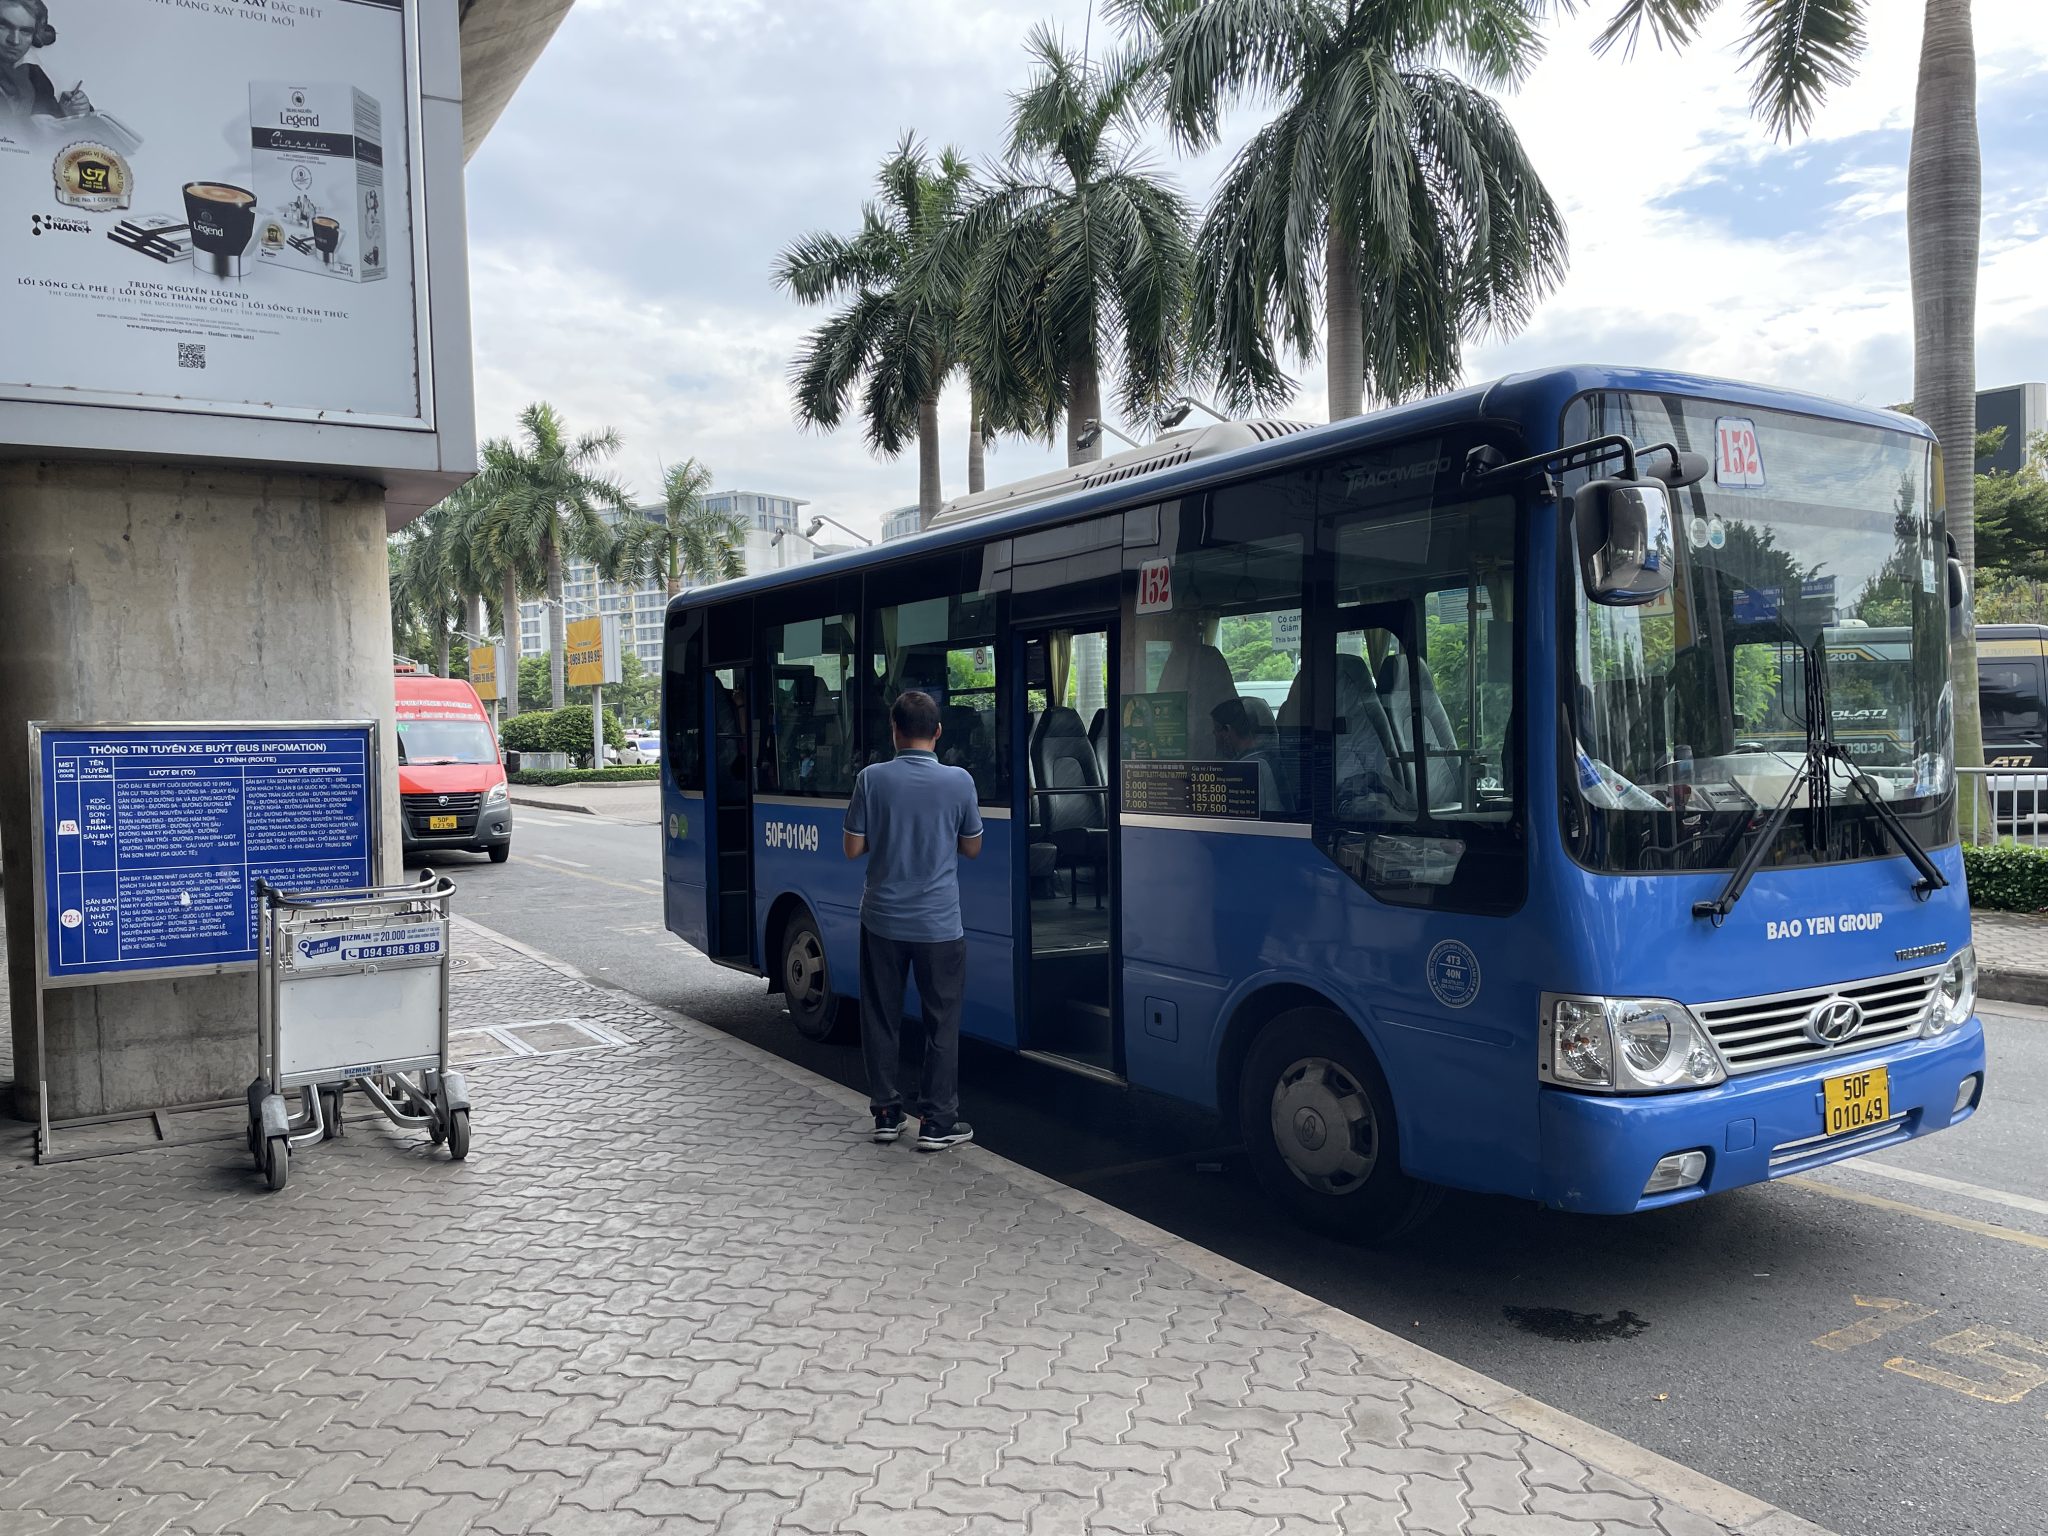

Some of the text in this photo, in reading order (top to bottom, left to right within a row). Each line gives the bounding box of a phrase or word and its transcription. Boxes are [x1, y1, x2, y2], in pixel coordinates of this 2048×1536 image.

[213, 5, 234, 17] XAY
[238, 9, 267, 23] TƯƠI
[271, 15, 295, 28] MỚI
[299, 6, 322, 19] BIỆT
[280, 111, 319, 129] Legend
[80, 167, 106, 182] G7
[53, 216, 71, 224] CÔNG
[192, 220, 223, 238] Legend
[39, 279, 68, 290] SỐNG
[71, 282, 86, 292] CÀ
[88, 284, 110, 295] PHÊ
[171, 292, 206, 303] THÀNH
[209, 297, 239, 307] CÔNG
[128, 280, 249, 301] TRUNG NGUYÊN LEGEND
[1719, 428, 1758, 475] 152
[1140, 565, 1170, 605] 152
[89, 742, 327, 755] THÔNG TIN TUYẾN XE BUÝT (BUS INFOMATION)
[227, 755, 247, 764] TRÌNH
[248, 755, 277, 765] (ROUTE)
[84, 766, 109, 774] TUYẾN
[149, 769, 170, 778] LƯỢT
[180, 769, 196, 777] (TO)
[277, 767, 297, 776] LƯỢT
[309, 766, 341, 775] (RETURN)
[1191, 773, 1216, 783] 3.000
[1125, 781, 1147, 791] 5.000
[1191, 784, 1227, 794] 112.500
[1125, 790, 1147, 800] 6.000
[1191, 793, 1227, 803] 135.000
[1125, 800, 1148, 810] 7.000
[1191, 803, 1227, 814] 157.500
[61, 823, 76, 833] 152
[83, 832, 115, 841] SÂN BAY
[765, 821, 819, 852] 50F-01049
[92, 839, 107, 847] TSN
[62, 914, 81, 924] 72-1
[1766, 911, 1884, 940] BAO YEN GROUP
[341, 933, 372, 942] BIZMAN
[380, 929, 406, 942] 20.000
[363, 942, 436, 958] 094.986.98.98
[1445, 955, 1461, 966] 4T3
[1445, 968, 1462, 981] 40N
[344, 1066, 372, 1076] BIZMAN
[1843, 1073, 1871, 1102] 50F
[1832, 1096, 1884, 1132] 010.49
